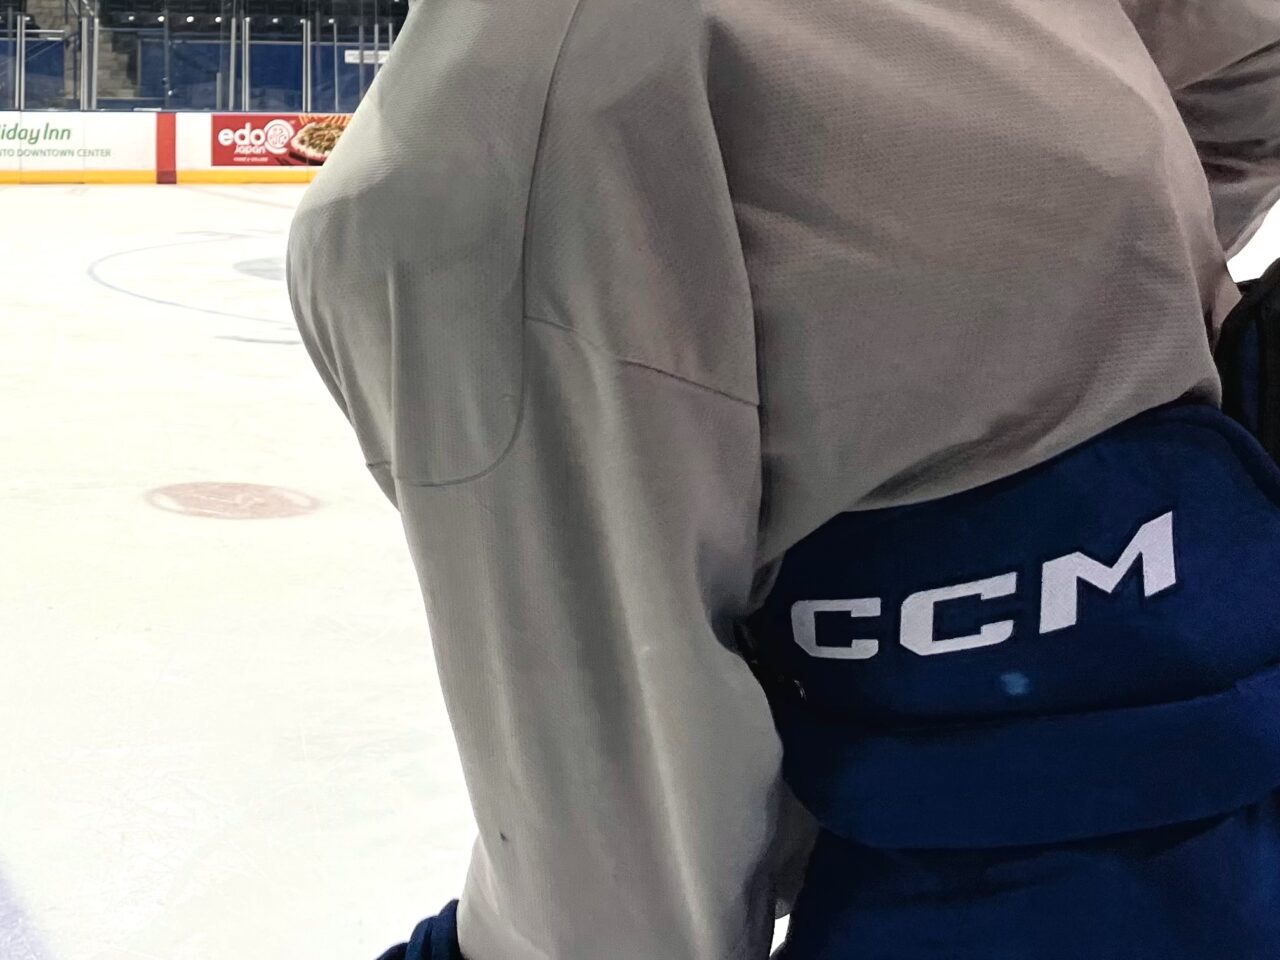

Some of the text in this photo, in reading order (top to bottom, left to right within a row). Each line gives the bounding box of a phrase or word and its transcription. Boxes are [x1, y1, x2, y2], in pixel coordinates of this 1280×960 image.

[43, 122, 71, 141] Inn
[218, 122, 266, 146] edo
[17, 148, 75, 157] DOWNTOWN
[77, 148, 111, 157] CENTER
[791, 511, 1176, 659] CCM
